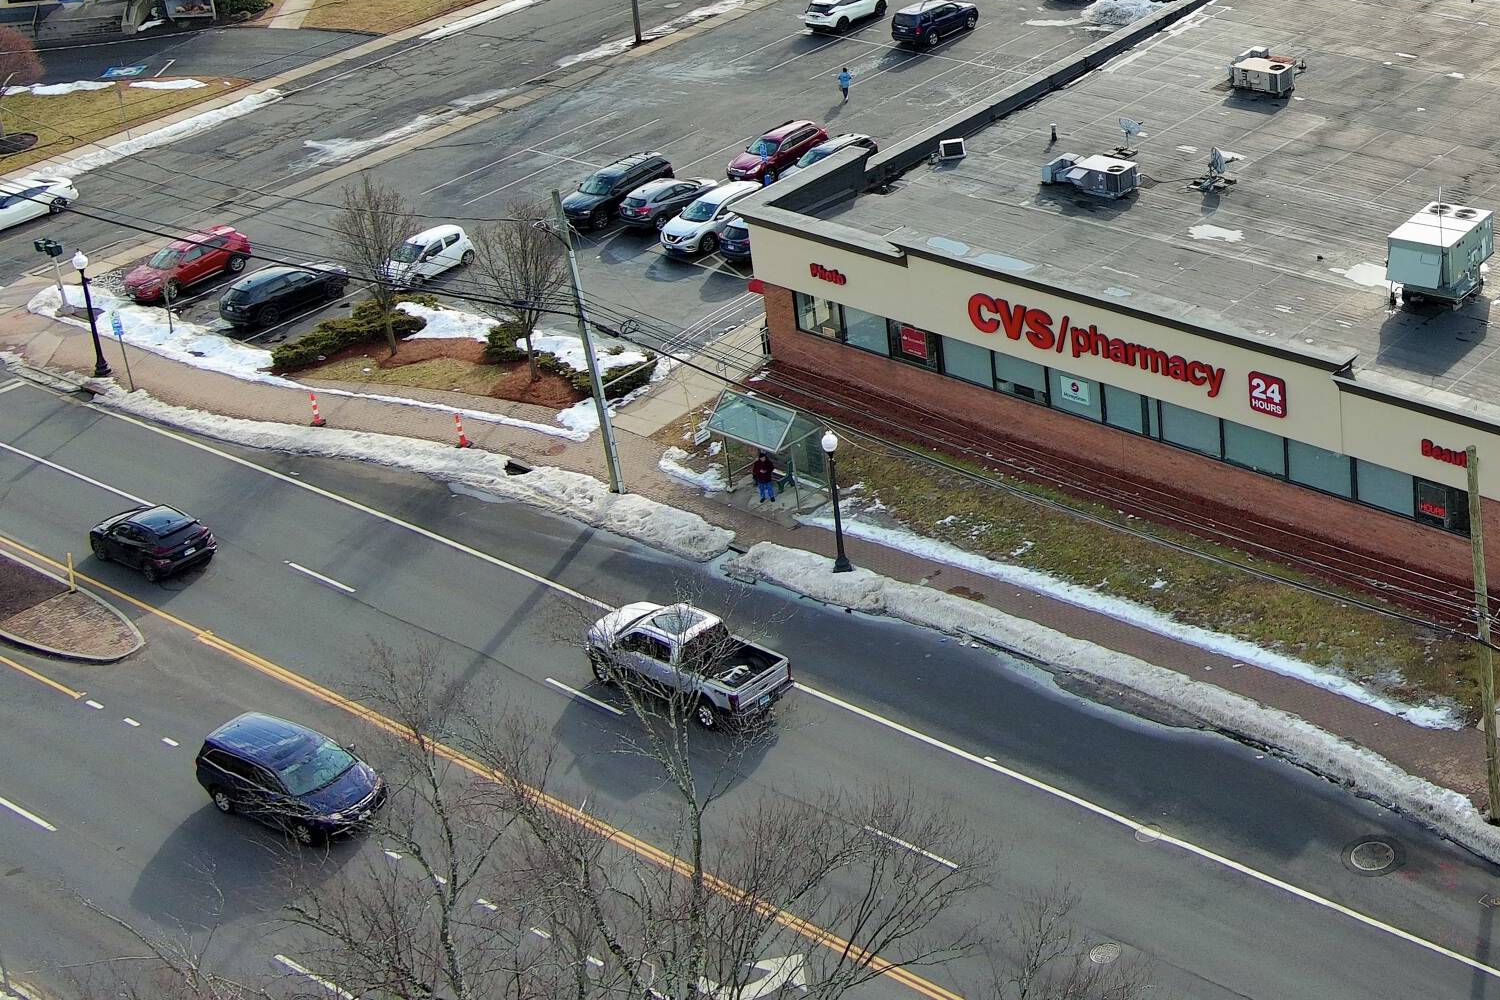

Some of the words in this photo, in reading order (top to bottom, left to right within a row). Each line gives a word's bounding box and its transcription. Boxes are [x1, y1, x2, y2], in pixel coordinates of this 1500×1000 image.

[809, 263, 847, 286] Photo
[968, 293, 1225, 397] CVS/pharmacy
[1251, 378, 1282, 403] 24
[1251, 398, 1282, 414] HOURS
